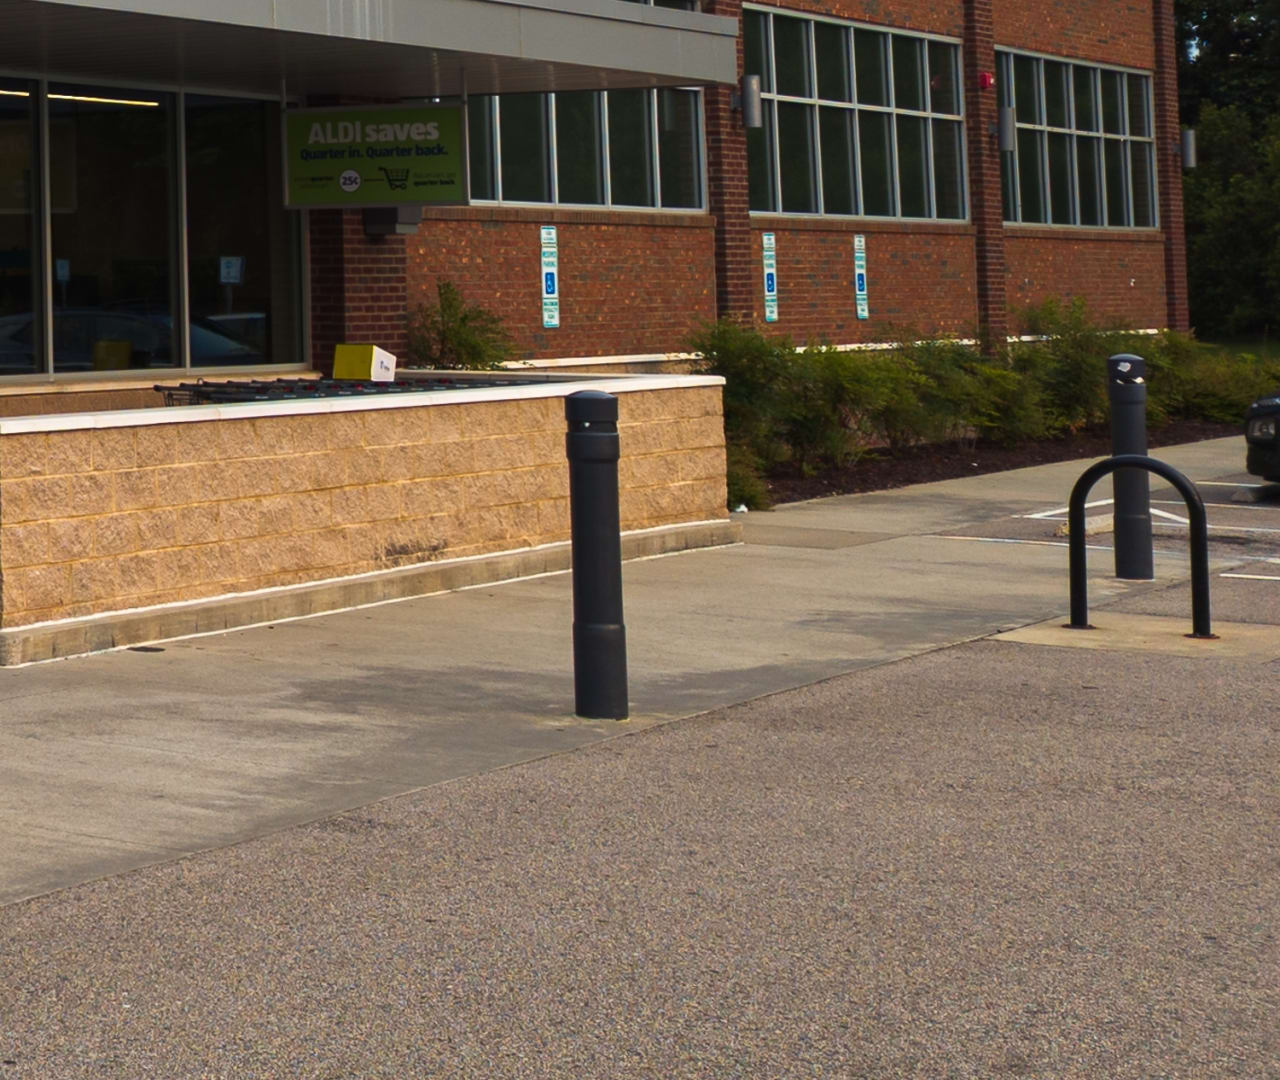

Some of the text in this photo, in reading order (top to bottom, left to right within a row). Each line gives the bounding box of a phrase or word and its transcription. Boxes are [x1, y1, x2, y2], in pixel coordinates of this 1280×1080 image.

[307, 120, 440, 145] ALDI saves
[300, 143, 449, 162] Quarter in. Quarter back.
